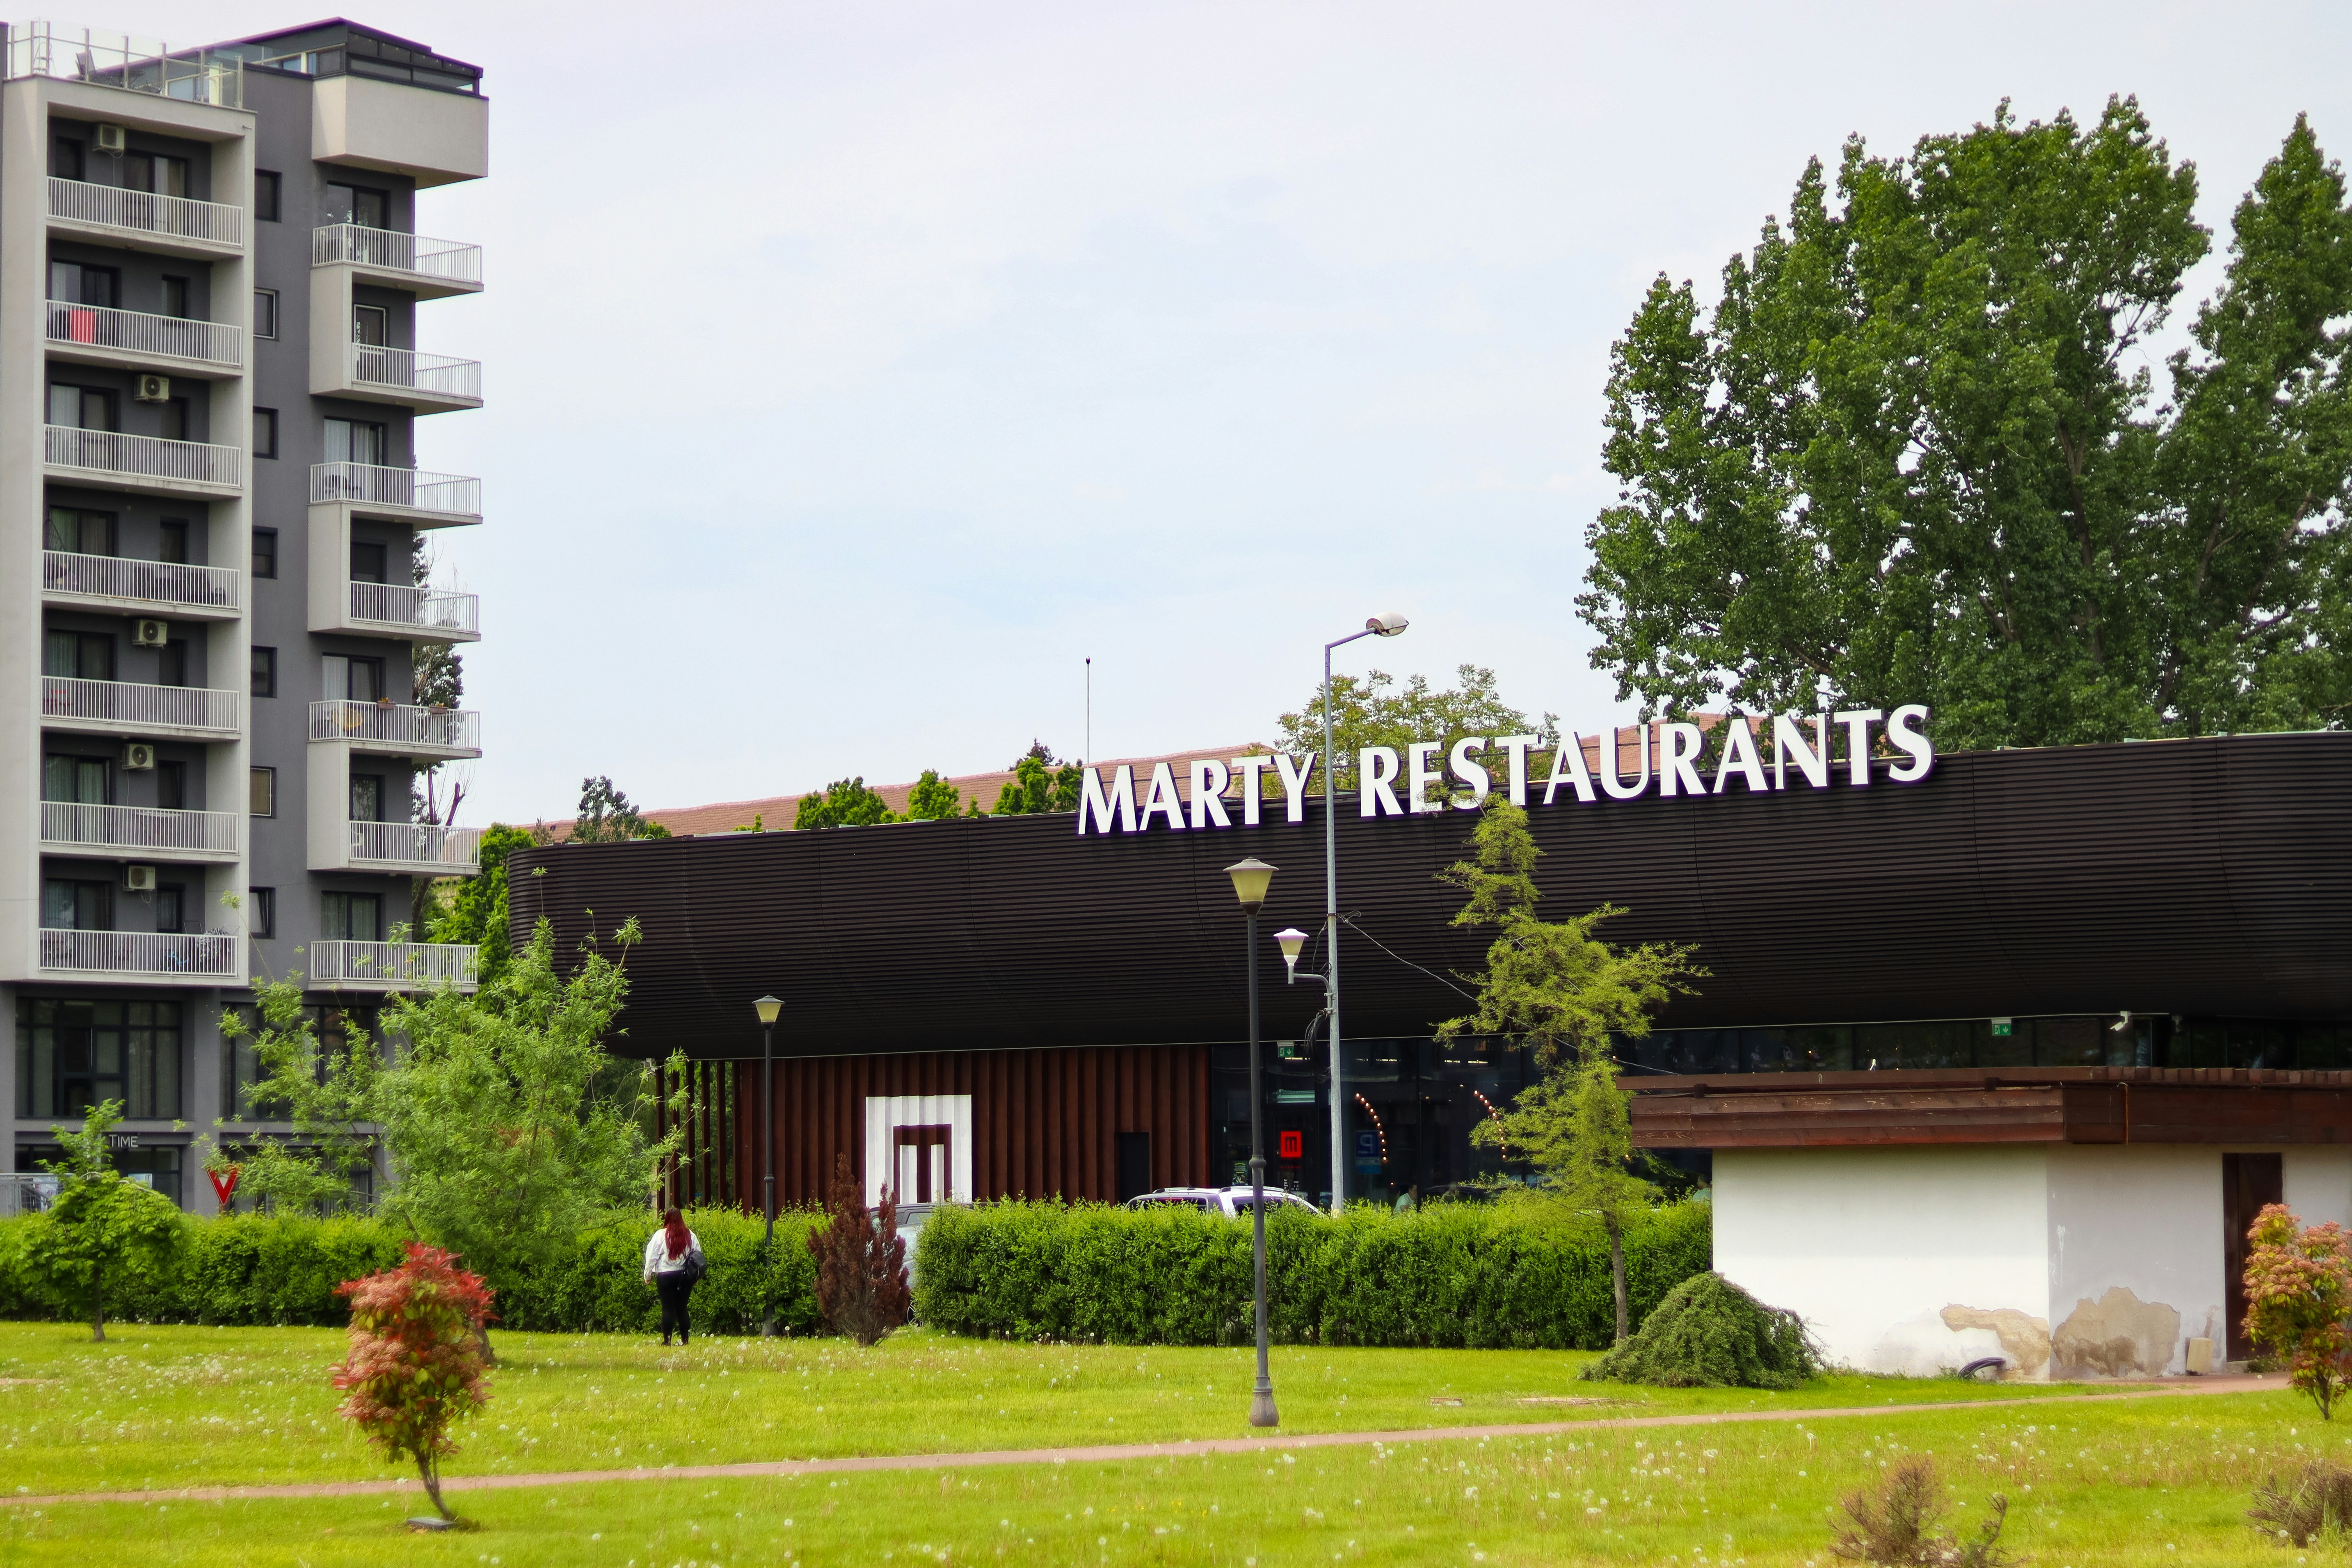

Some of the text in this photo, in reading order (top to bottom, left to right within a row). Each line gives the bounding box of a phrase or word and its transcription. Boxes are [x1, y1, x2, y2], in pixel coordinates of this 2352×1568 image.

[1078, 704, 1935, 834] MARTY RESTAURANTS
[108, 1134, 138, 1148] TIME
